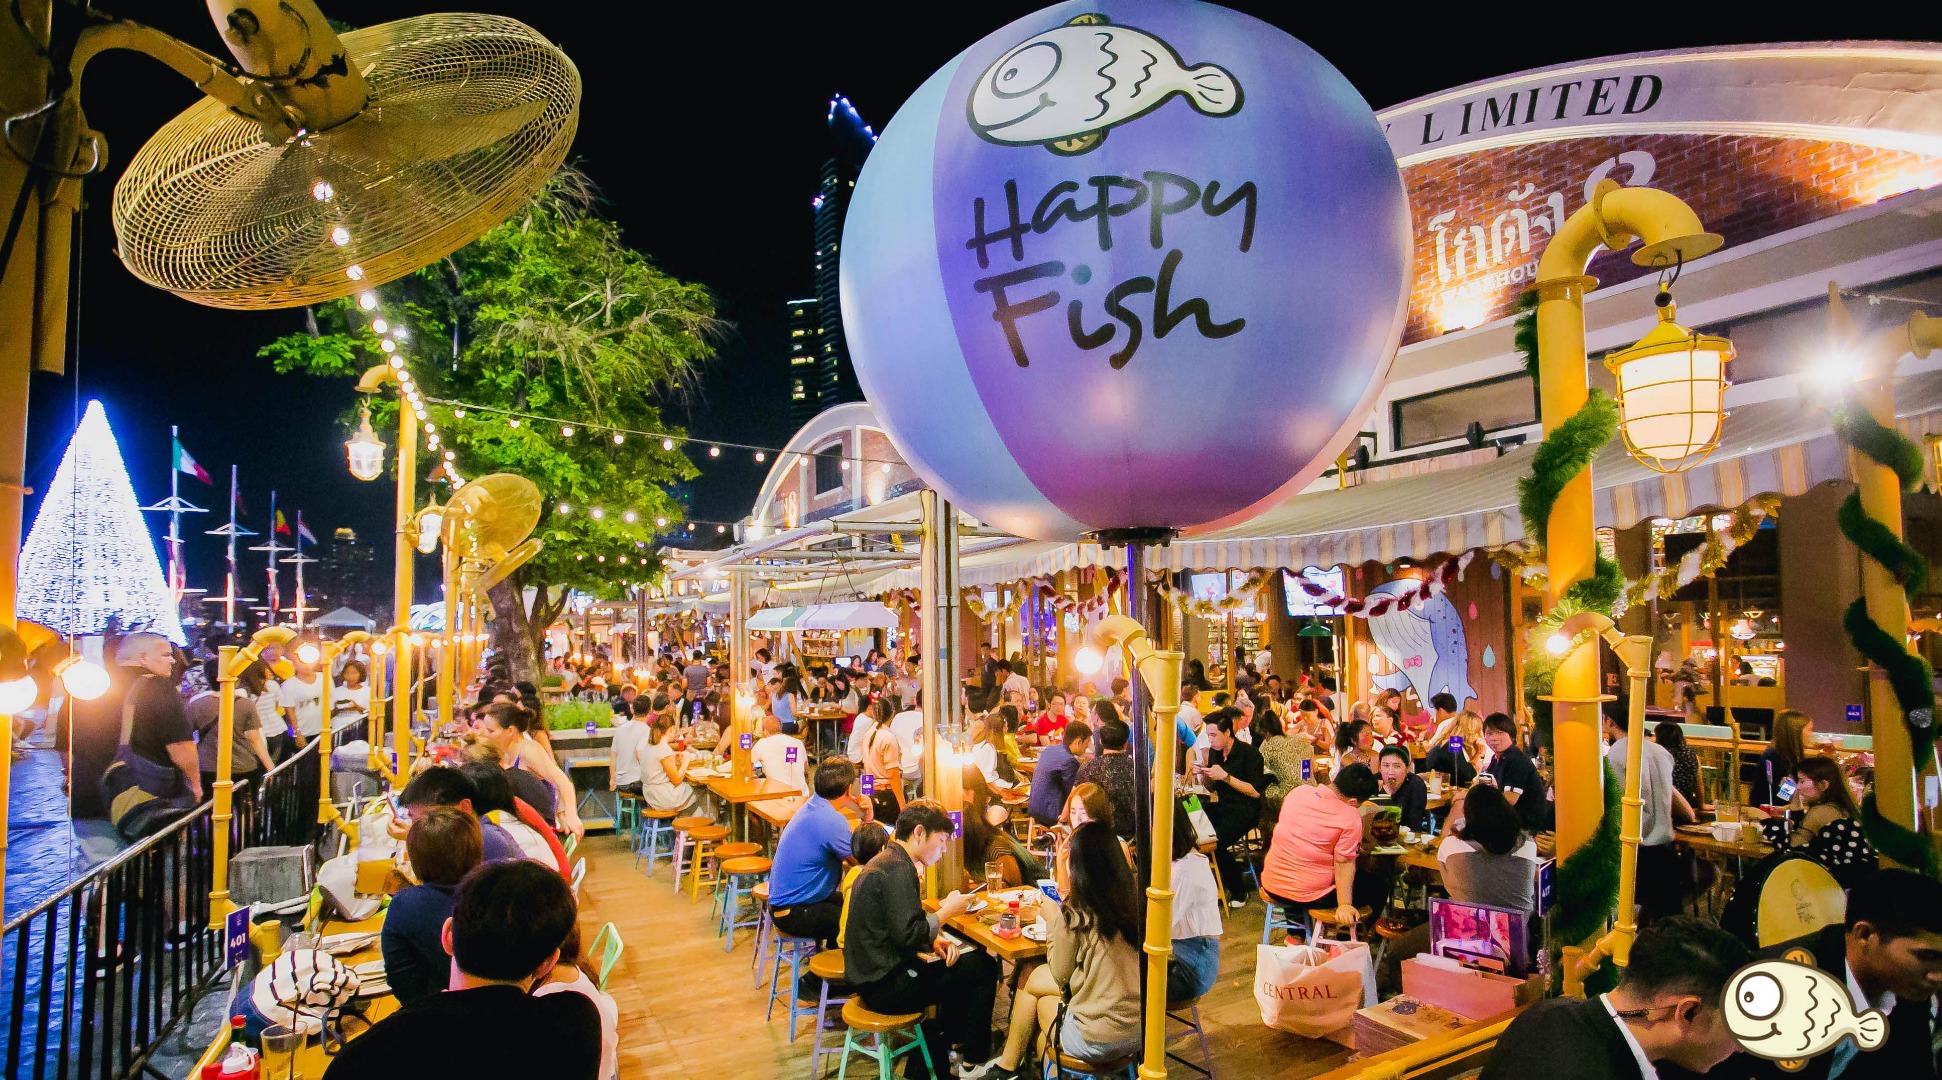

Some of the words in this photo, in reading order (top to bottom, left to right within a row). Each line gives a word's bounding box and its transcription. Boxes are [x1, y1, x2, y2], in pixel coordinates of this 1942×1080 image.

[1420, 74, 1663, 145] LIMITED
[965, 170, 1258, 269] Happy
[973, 248, 1246, 370] Fish
[1440, 260, 1540, 306] WAREHOU
[230, 932, 246, 949] 401
[1262, 981, 1338, 1000] CENTRAL
